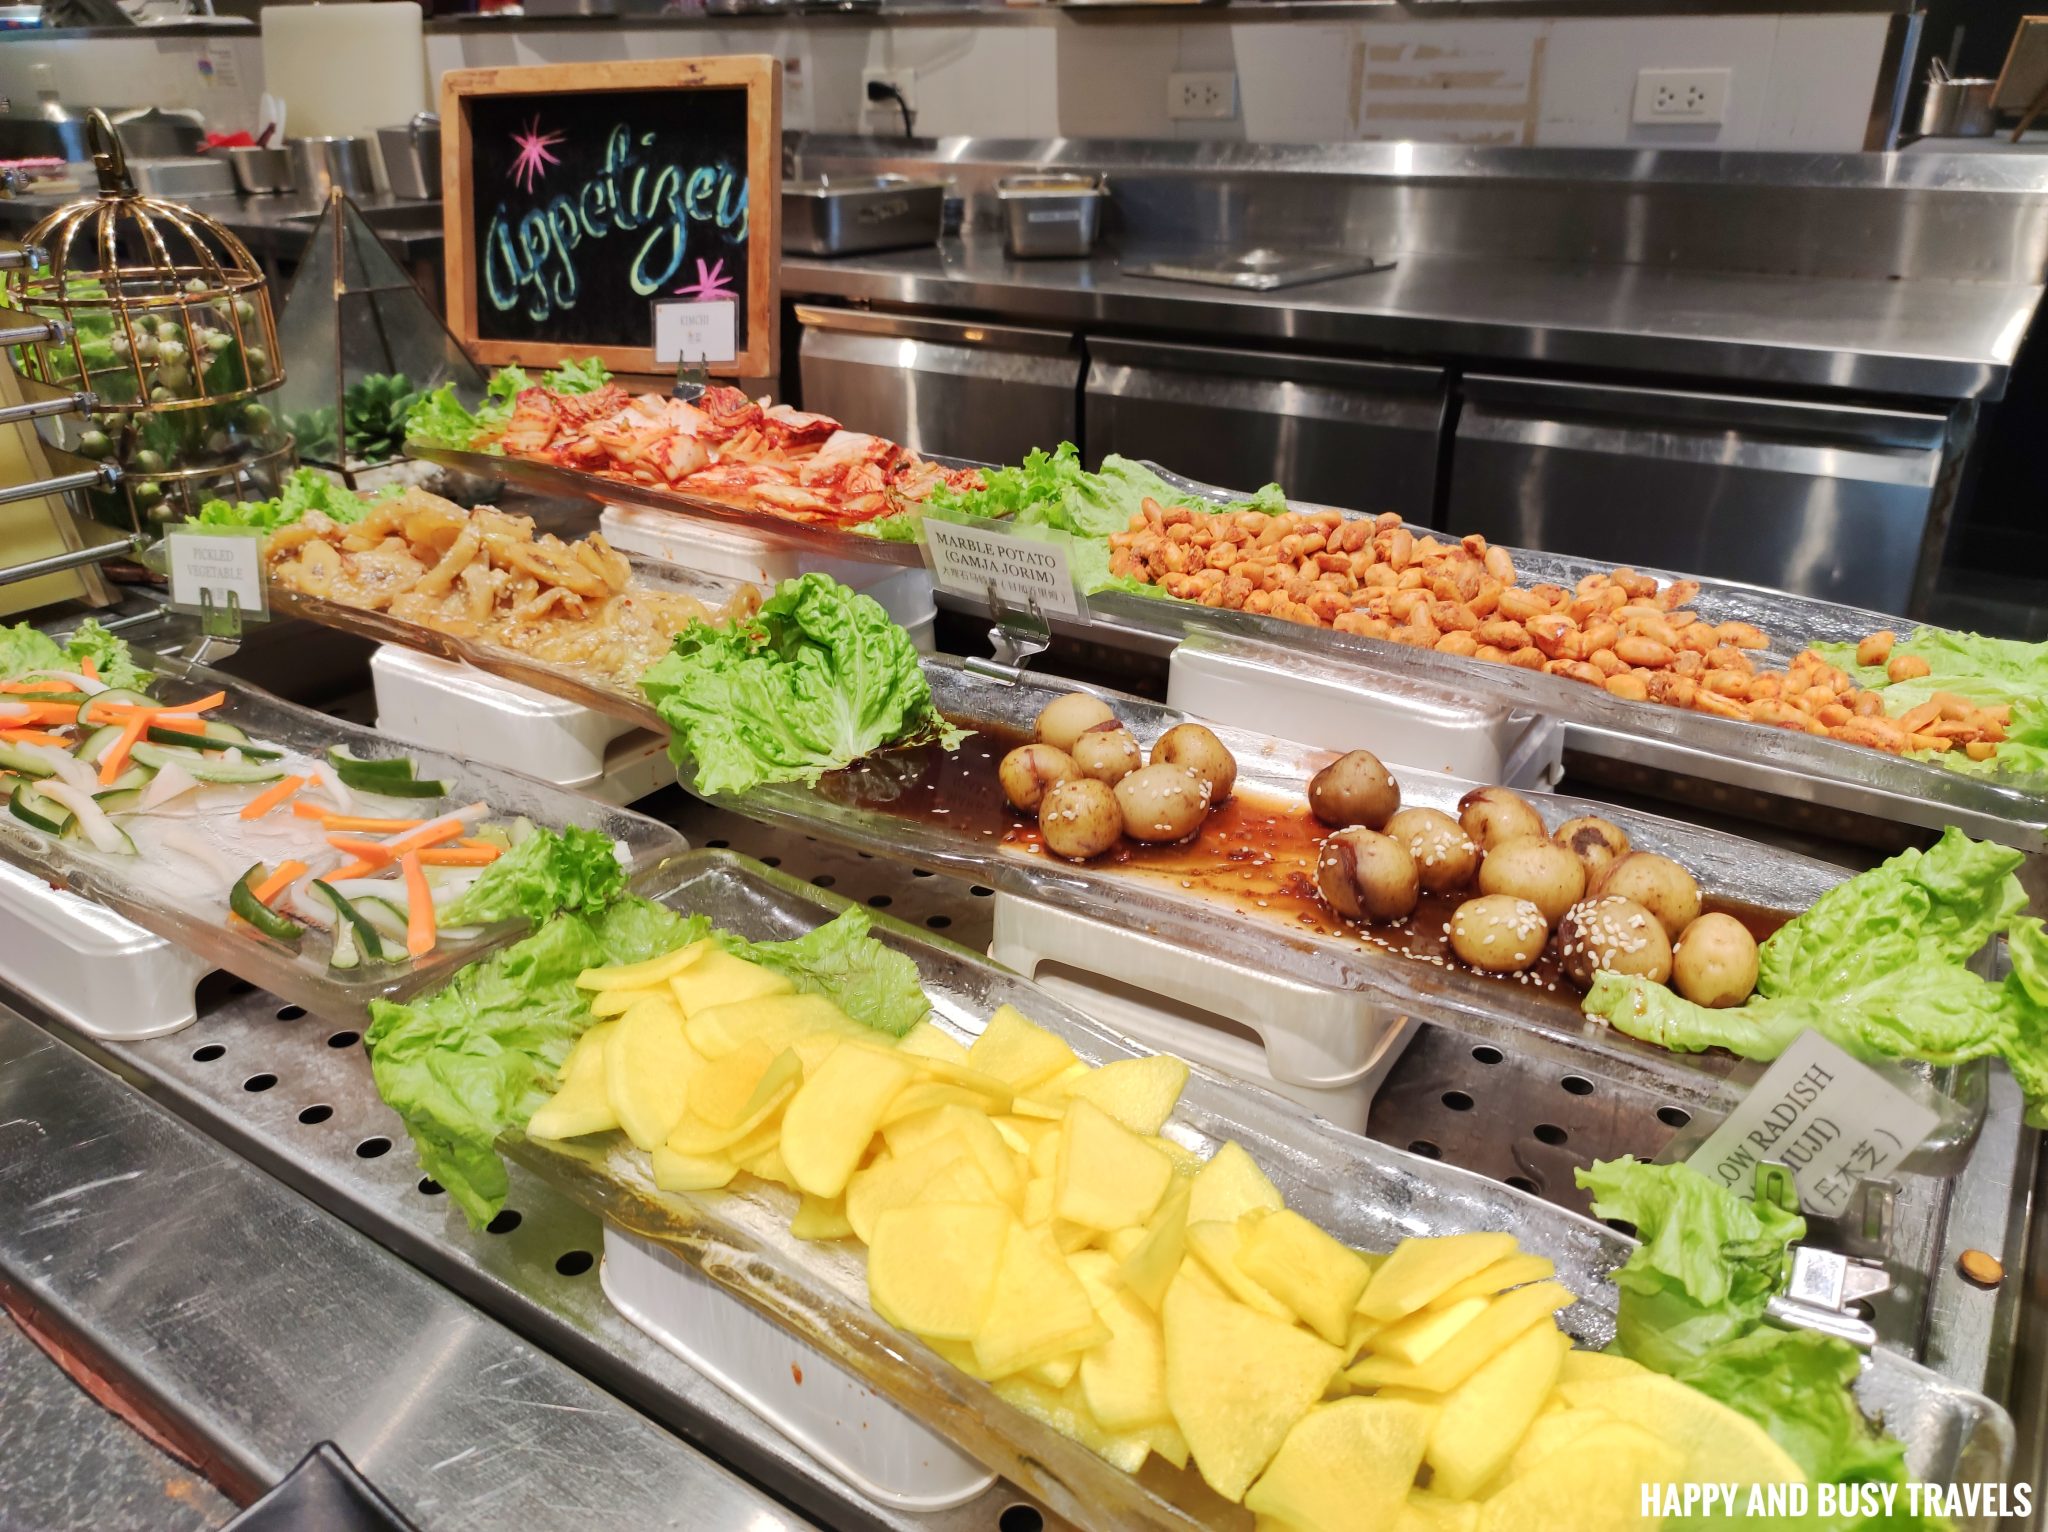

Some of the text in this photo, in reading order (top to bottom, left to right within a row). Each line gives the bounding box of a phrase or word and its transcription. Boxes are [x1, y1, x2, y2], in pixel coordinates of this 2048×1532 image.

[680, 314, 710, 327] KIMCHI
[193, 547, 235, 562] PICKLED
[935, 532, 1056, 569] MARBLE POTATO
[186, 564, 244, 580] VEGETABLE
[944, 550, 999, 573] (GAMJA
[1002, 562, 1056, 586] JORIM)
[1747, 1062, 1834, 1151] RADISH
